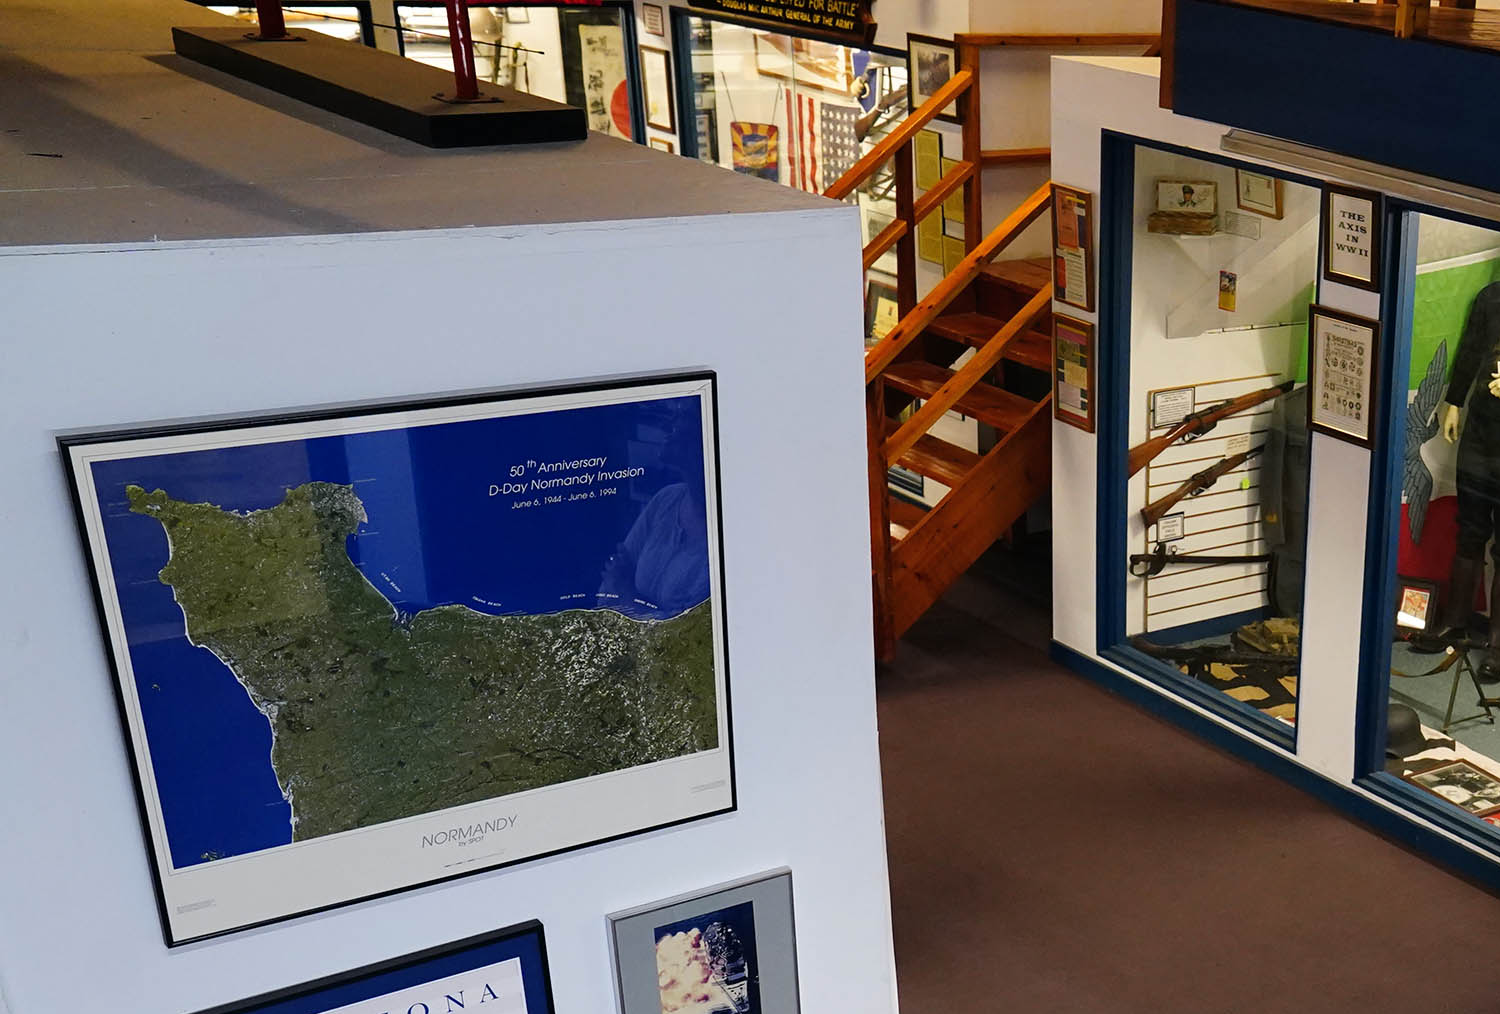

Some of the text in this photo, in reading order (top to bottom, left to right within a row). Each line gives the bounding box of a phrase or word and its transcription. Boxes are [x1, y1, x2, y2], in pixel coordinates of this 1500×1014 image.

[785, 9, 811, 23] GENERAL
[812, 14, 821, 24] OF
[822, 16, 834, 26] THE
[834, 19, 854, 30] ARMY
[1340, 210, 1365, 223] THE
[1338, 221, 1368, 234] AXIS
[1346, 234, 1360, 244] IN
[538, 456, 607, 474] Anniversary
[489, 466, 645, 497] D-Day Normandy Invasion
[512, 499, 532, 509] June
[544, 495, 562, 505] 1944
[568, 492, 588, 502] June
[599, 487, 617, 497] 1994
[422, 815, 518, 848] NORMANDY
